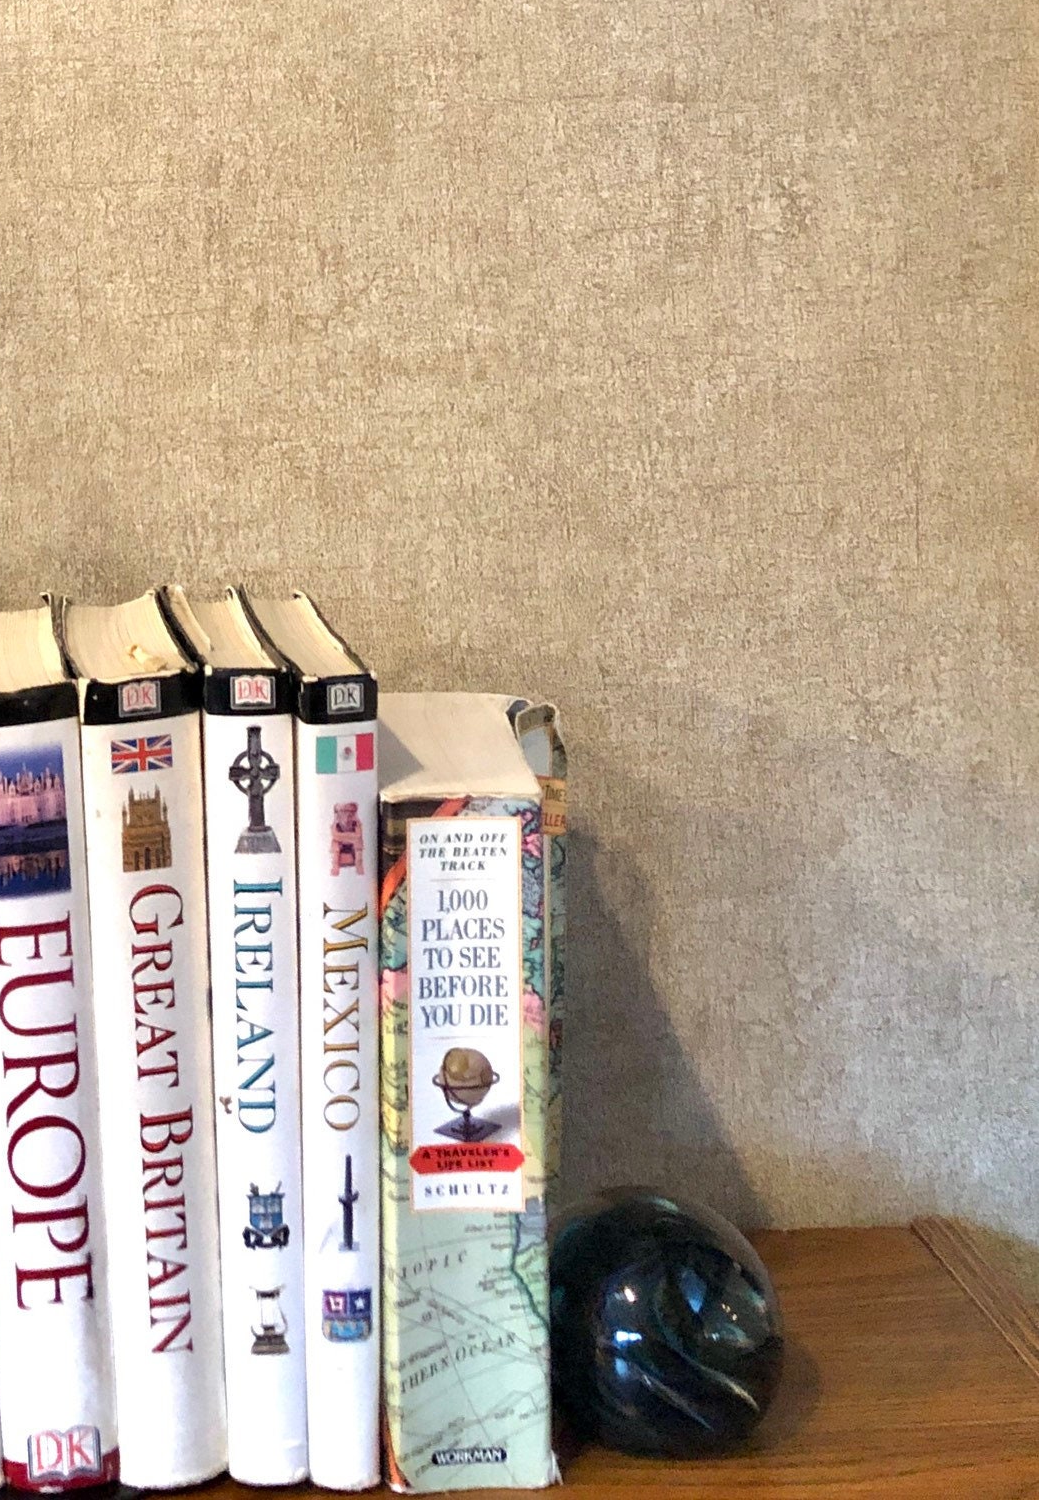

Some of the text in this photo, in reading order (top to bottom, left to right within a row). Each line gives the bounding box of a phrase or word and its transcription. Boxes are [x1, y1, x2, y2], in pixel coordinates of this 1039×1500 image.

[124, 687, 154, 708] DK
[237, 677, 270, 700] DK
[333, 688, 360, 706] DK
[419, 832, 508, 845] ON AND OFF
[418, 846, 508, 859] THE BEATEN
[440, 860, 486, 871] TRACK
[437, 888, 489, 915] 1,000
[421, 917, 506, 942] PLACES
[423, 946, 502, 970] TO SEE
[418, 974, 509, 999] BEFORE
[233, 877, 283, 1134] IRELAND
[322, 902, 369, 1132] MEXICO
[421, 1003, 463, 1029] YOU
[469, 1003, 509, 1026] DIE
[128, 883, 194, 1355] GREAT BRITAIN
[422, 1147, 511, 1159] A TRAVELER'S
[436, 1159, 495, 1171] LIFE LIST
[424, 1183, 509, 1198] SCHULTZ
[35, 1428, 94, 1471] DK
[434, 1448, 503, 1464] WORKMAN
